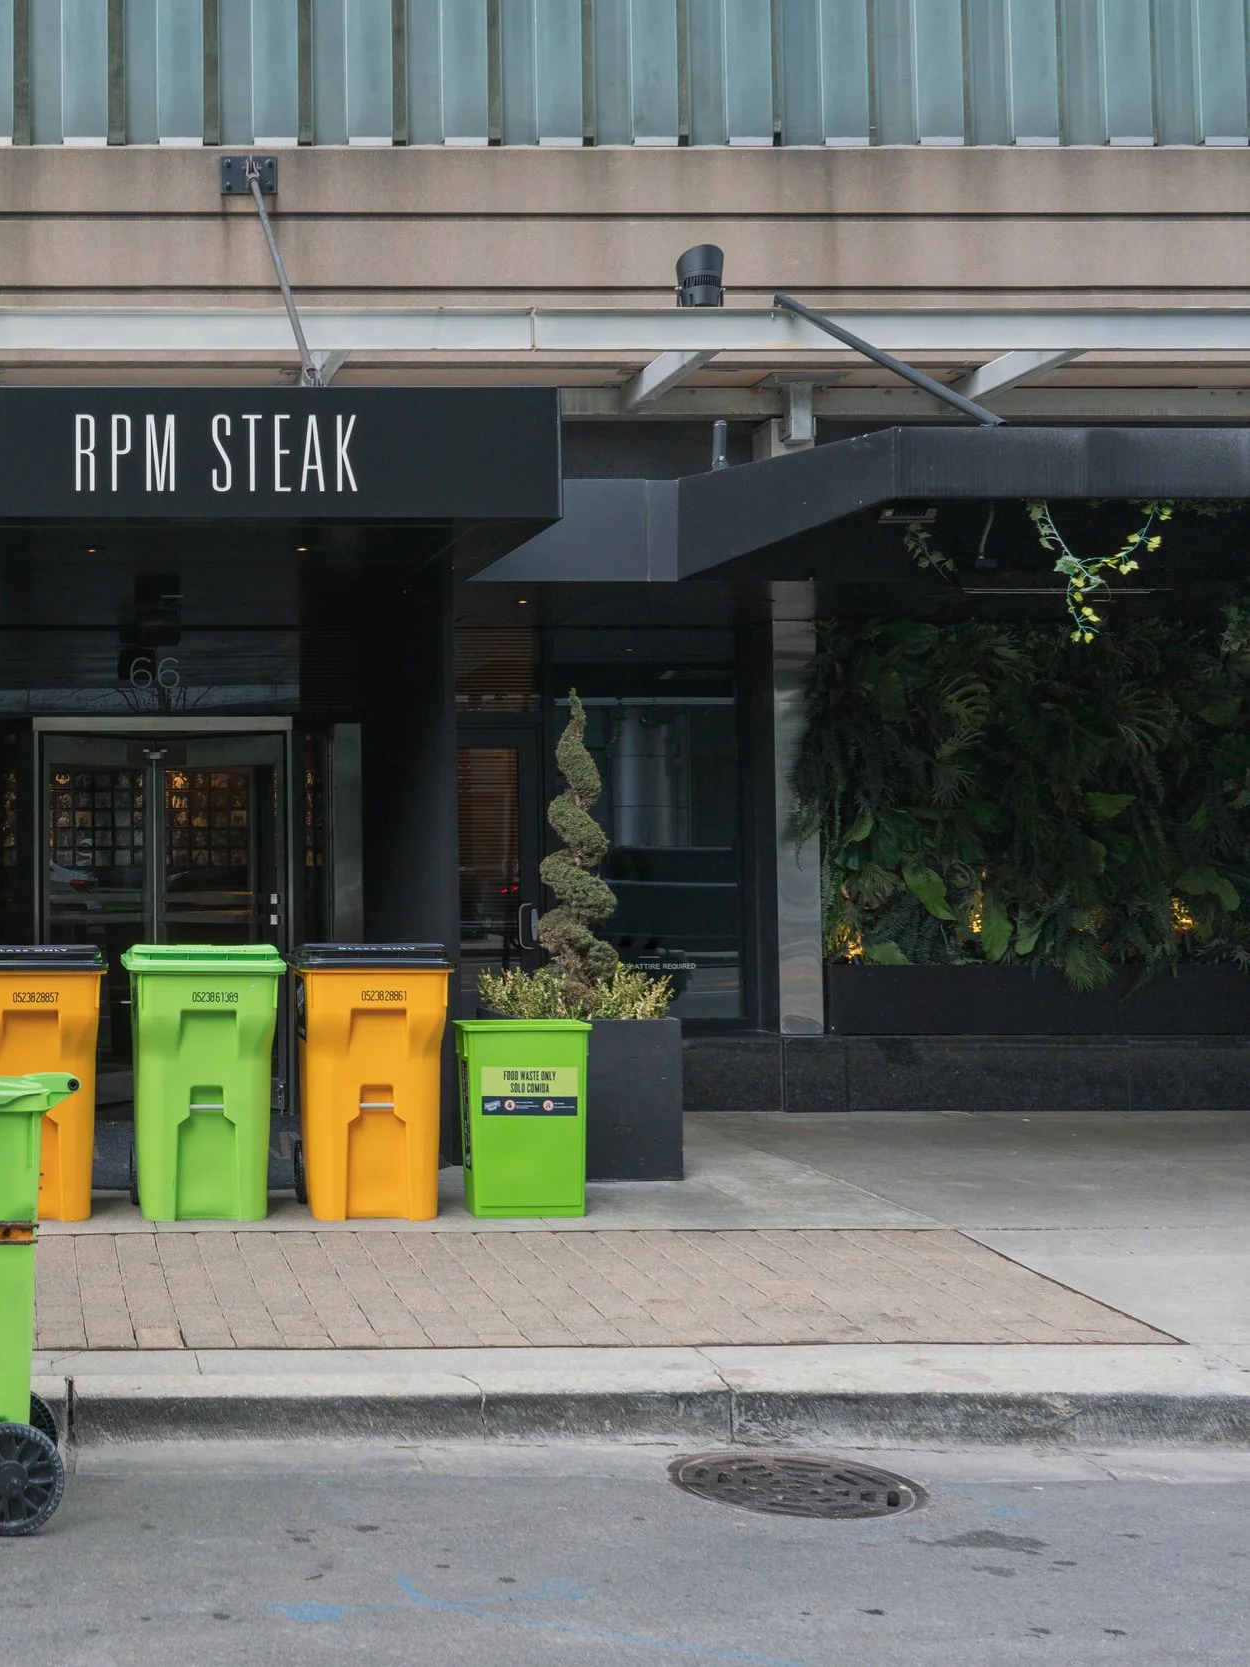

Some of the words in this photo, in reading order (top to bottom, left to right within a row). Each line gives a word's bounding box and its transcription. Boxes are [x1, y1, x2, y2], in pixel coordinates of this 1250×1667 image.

[75, 414, 175, 492] RPM
[211, 414, 358, 492] STEAK
[130, 656, 180, 689] 66
[12, 992, 59, 1003] 0523828857
[361, 990, 407, 1001] 0523828861
[503, 1070, 519, 1081] FOOD
[520, 1070, 539, 1081] WASTE
[541, 1070, 557, 1081] ONLY
[510, 1083, 526, 1093] SOLO
[526, 1083, 550, 1093] COMIDA
